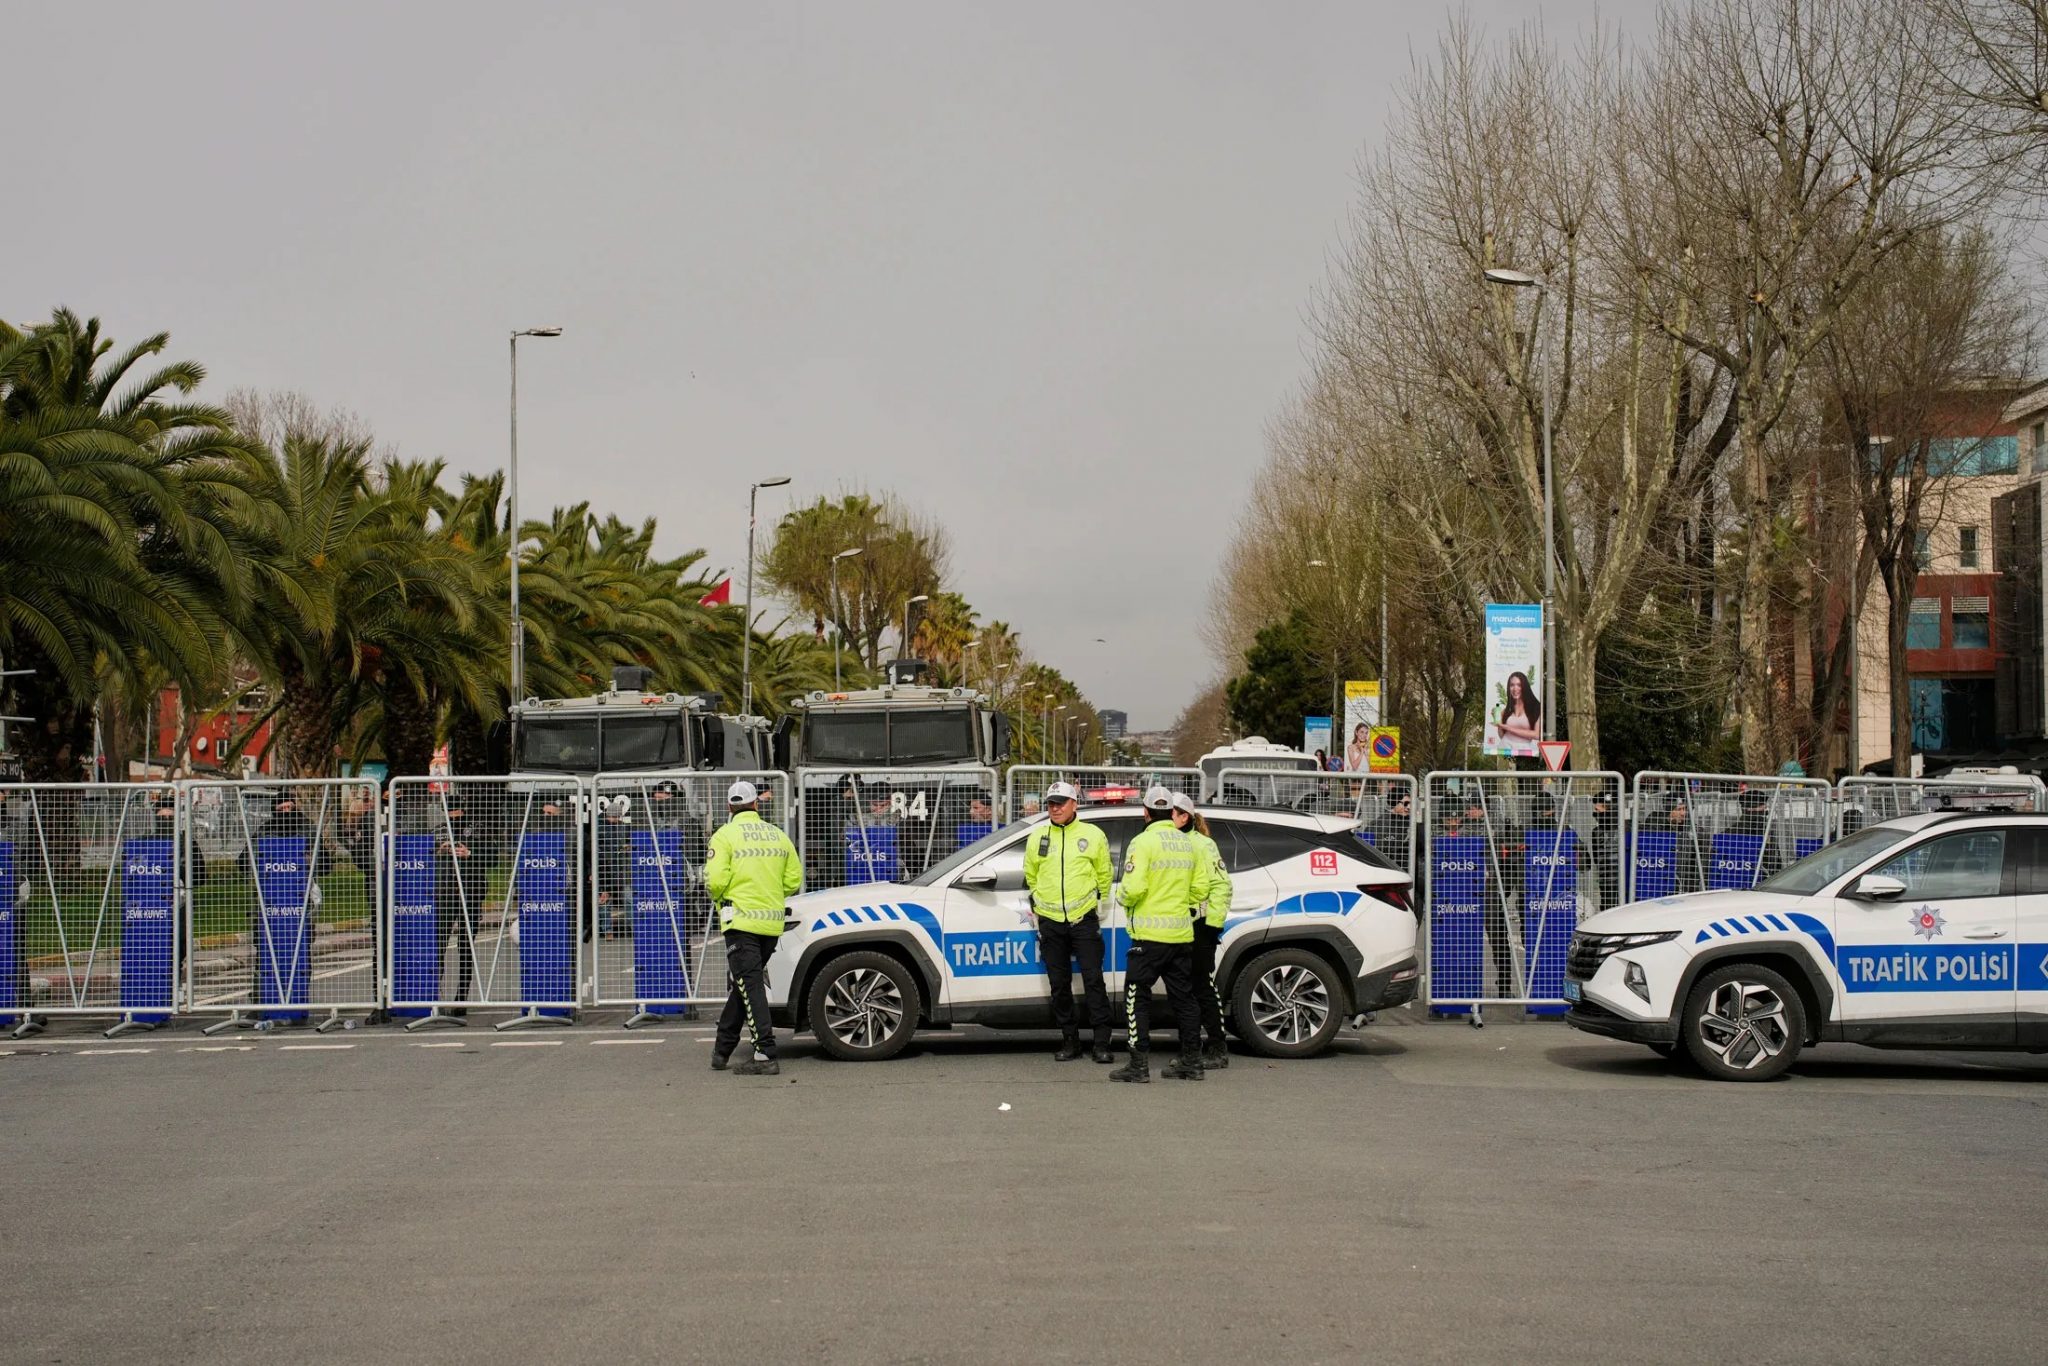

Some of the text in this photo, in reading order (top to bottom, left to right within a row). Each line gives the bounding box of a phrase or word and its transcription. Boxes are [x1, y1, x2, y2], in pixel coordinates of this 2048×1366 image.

[1491, 615, 1536, 623] maru-derm
[524, 856, 557, 868] POLİS
[853, 850, 887, 862] POİS
[1313, 854, 1334, 867] 112
[265, 860, 297, 872] POLİS
[1441, 860, 1475, 871] POLİS
[1637, 857, 1665, 868] OLİS
[130, 863, 162, 876] POLİS
[266, 904, 280, 917] EVİK
[394, 904, 408, 915] EVİK
[656, 900, 679, 910] KUVET
[952, 937, 1028, 966] TRAFİK
[1848, 950, 2009, 982] TRAFİK POLİSİ
